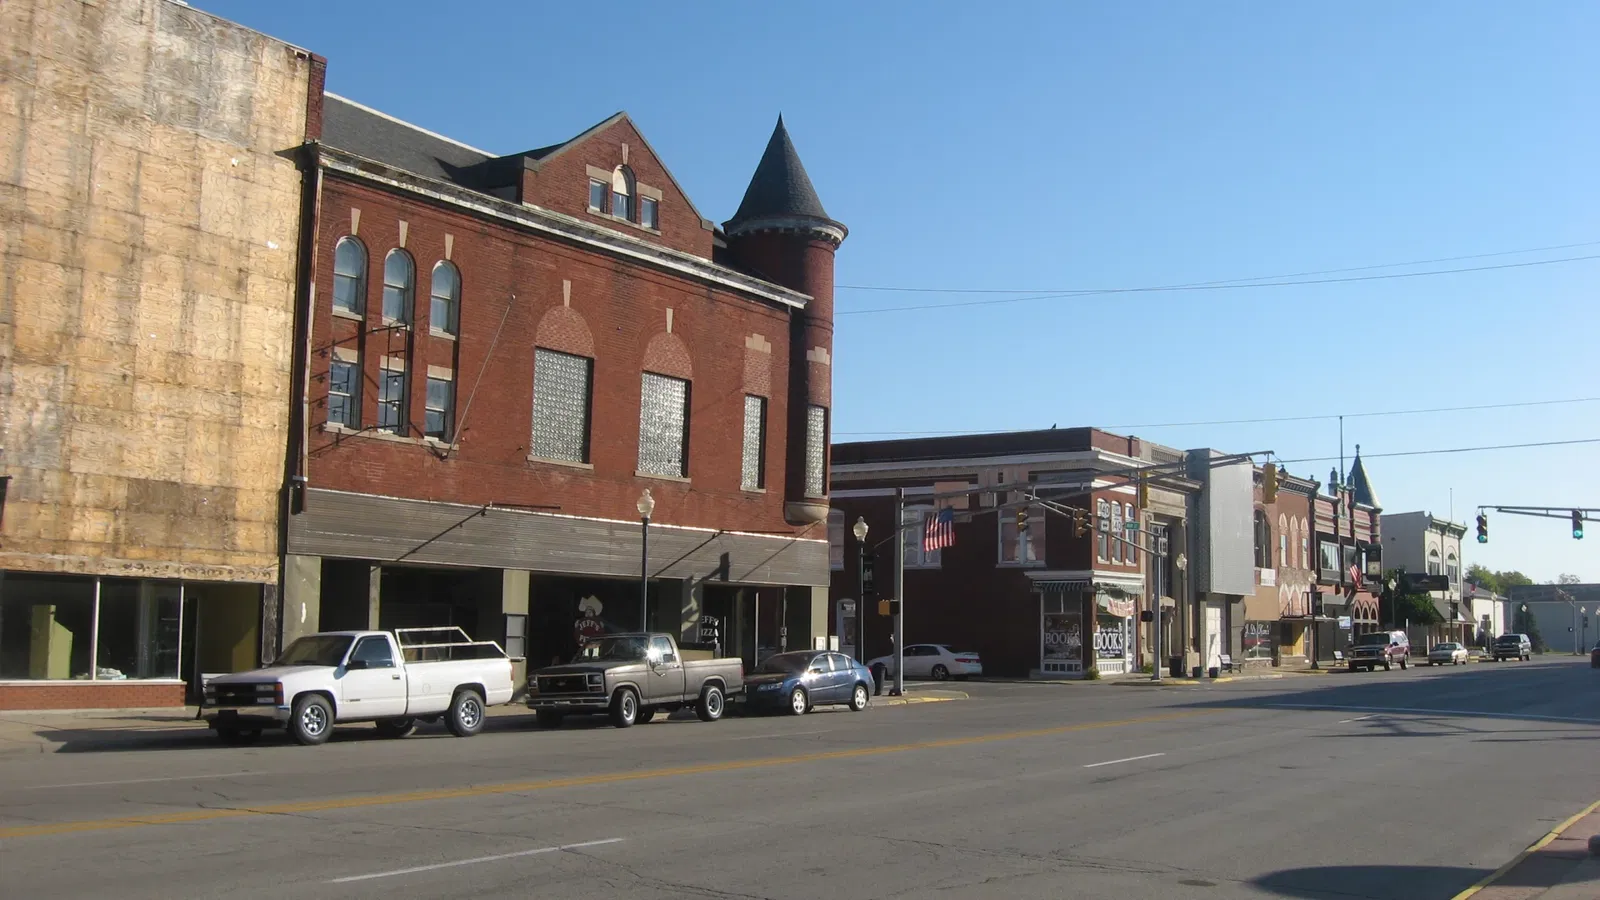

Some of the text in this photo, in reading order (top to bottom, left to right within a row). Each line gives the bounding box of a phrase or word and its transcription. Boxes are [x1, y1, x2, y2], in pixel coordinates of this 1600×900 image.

[700, 628, 719, 637] IZZA
[1045, 632, 1080, 645] BOOKS
[1093, 632, 1123, 650] BOOKS
